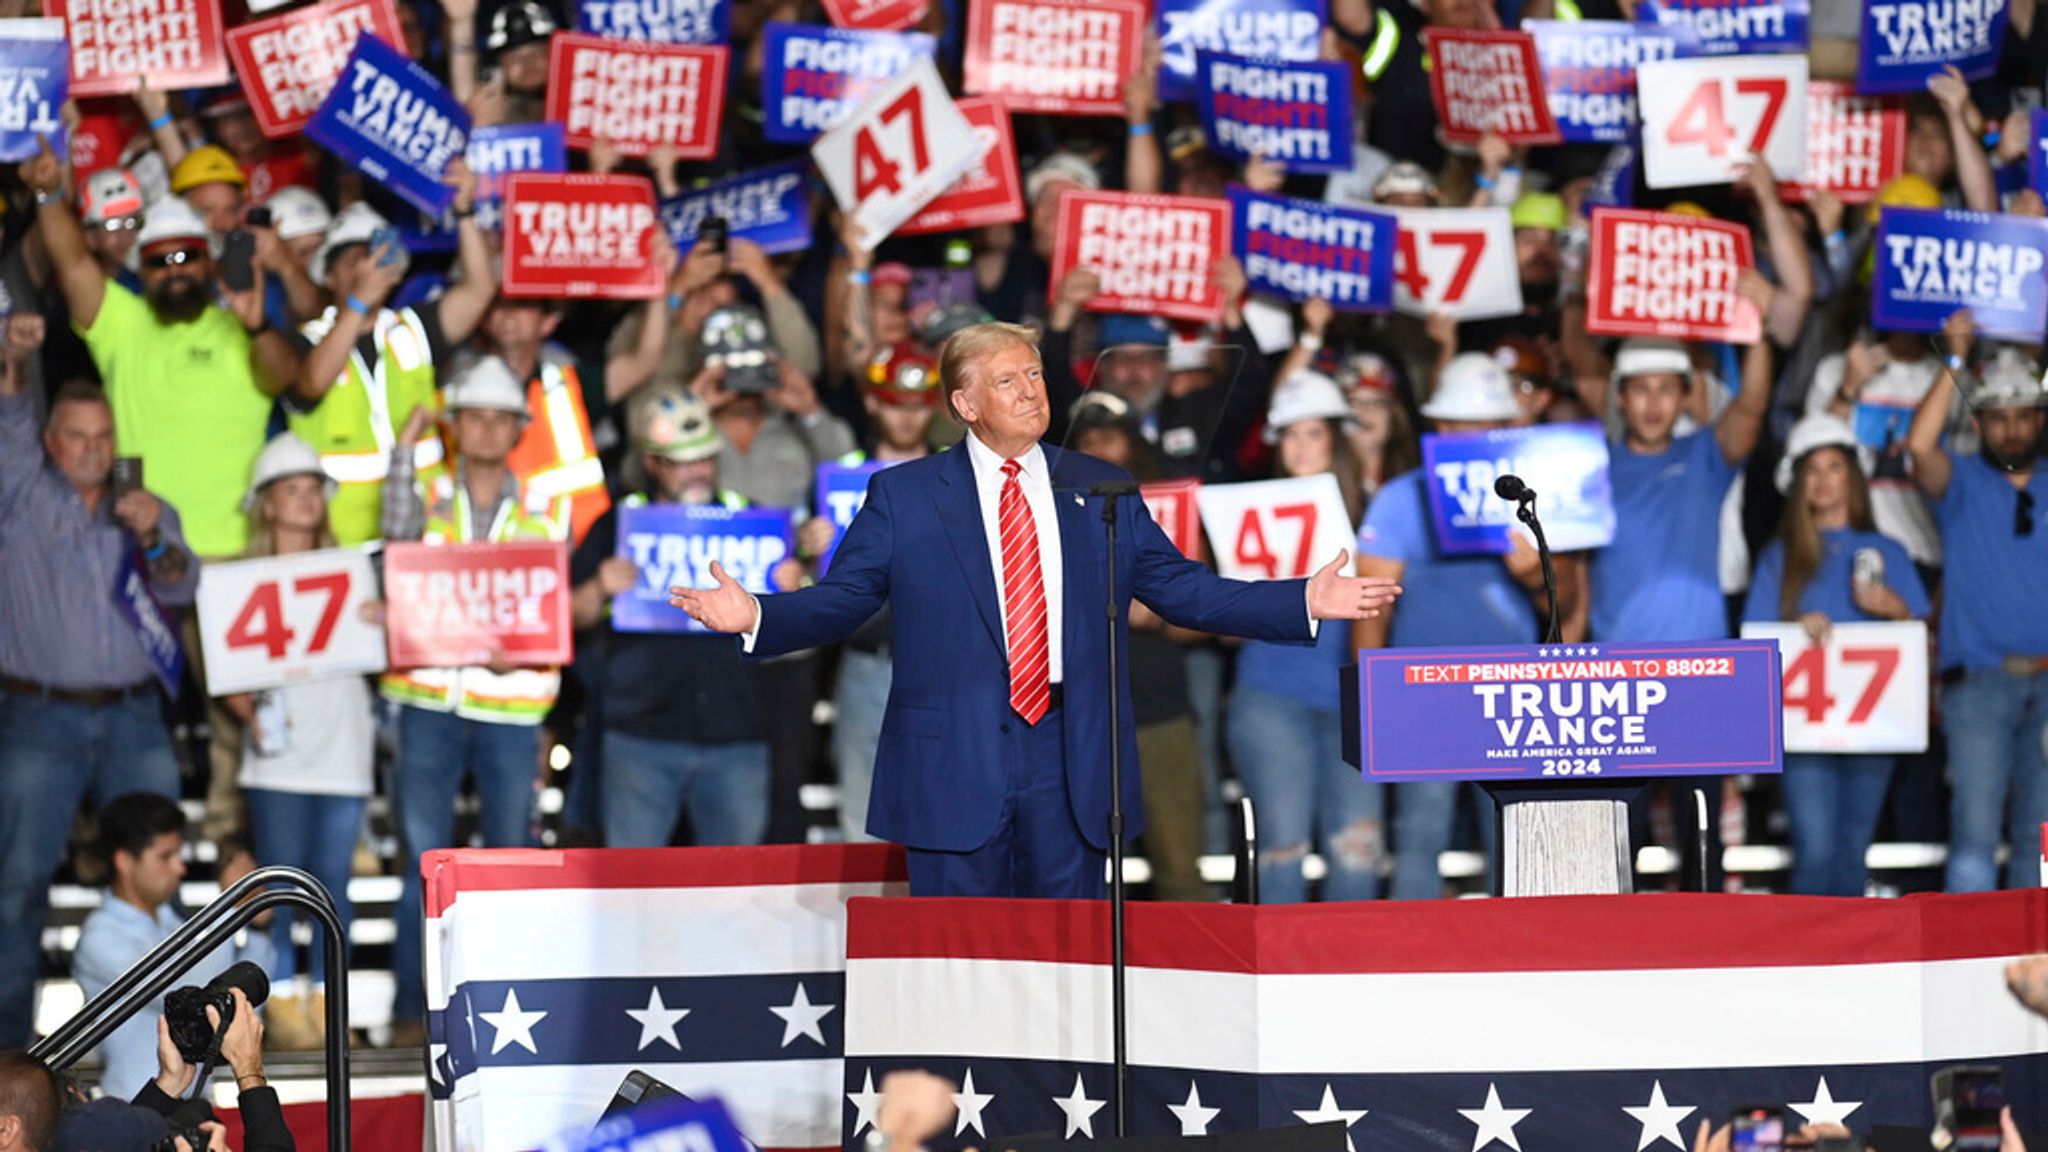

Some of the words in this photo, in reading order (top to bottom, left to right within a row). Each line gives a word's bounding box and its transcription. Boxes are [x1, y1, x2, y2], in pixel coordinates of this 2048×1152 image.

[70, 11, 199, 48] FIGHT!
[250, 4, 376, 65] FIGHT!
[993, 3, 1122, 40] FIGHT!
[1163, 10, 1320, 51] TRUMP
[1657, 5, 1786, 38] FIGHT!
[1870, 0, 2003, 36] TRUMP
[991, 33, 1120, 69] FIGHT!
[1551, 35, 1675, 66] FIGHT!
[1887, 20, 1990, 56] VANCE
[74, 38, 201, 79] FIGHT!
[261, 47, 350, 95] FIGH
[573, 48, 702, 85] FIGHT!
[1440, 40, 1524, 74] FIGHT!
[570, 77, 698, 113] FIGHT!
[784, 67, 868, 101] FIG
[989, 62, 1117, 98] FIGHT!
[1211, 62, 1328, 104] FIGHT!
[1444, 71, 1531, 103] FIGHT!
[1549, 66, 1637, 95] FIGH
[271, 81, 329, 121] FIG
[351, 58, 466, 154] TRUMP
[782, 95, 852, 130] FIG
[1213, 91, 1328, 129] FIGHT!
[1449, 100, 1538, 132] FIGHT!
[1550, 94, 1637, 126] FIGH
[1666, 78, 1788, 157] 47
[352, 93, 455, 177] VANCE
[568, 105, 695, 143] FIGHT!
[1215, 117, 1330, 160] FIGHT!
[465, 137, 542, 174] GHT!
[855, 84, 930, 203] 47
[514, 202, 655, 235] TRUMP
[1083, 203, 1211, 242] FIGHT!
[1247, 200, 1374, 251] FIGHT!
[529, 230, 641, 258] VANCE
[1079, 235, 1210, 271] FIGHT!
[1247, 230, 1372, 276] FIGHT!
[1615, 222, 1736, 258] FIGHT!
[1885, 234, 2044, 275] TRUMP
[1099, 266, 1206, 302] IGHT!
[1246, 253, 1370, 302] FIGHT!
[1394, 230, 1486, 303] 47
[1614, 254, 1738, 290] FIGHT!
[1901, 263, 2022, 300] VANCE
[1611, 285, 1735, 324] FIGHT!
[627, 533, 786, 570] TRUMP
[1233, 503, 1318, 580] 47
[401, 567, 557, 602] TRUMP
[224, 570, 351, 661] 47
[417, 594, 542, 626] VANCE
[1410, 665, 1462, 683] TEXT
[1468, 661, 1627, 680] PENNSYLVANIA
[1632, 660, 1660, 677] TO
[1665, 658, 1730, 676] 88022
[1783, 645, 1901, 724] 47
[1473, 680, 1667, 719] TRUMP
[1495, 716, 1646, 747] VANCE
[1486, 749, 1519, 759] MAKE
[1522, 748, 1573, 758] AMERICA
[1576, 747, 1613, 756] GREAT
[1541, 758, 1602, 776] 2024
